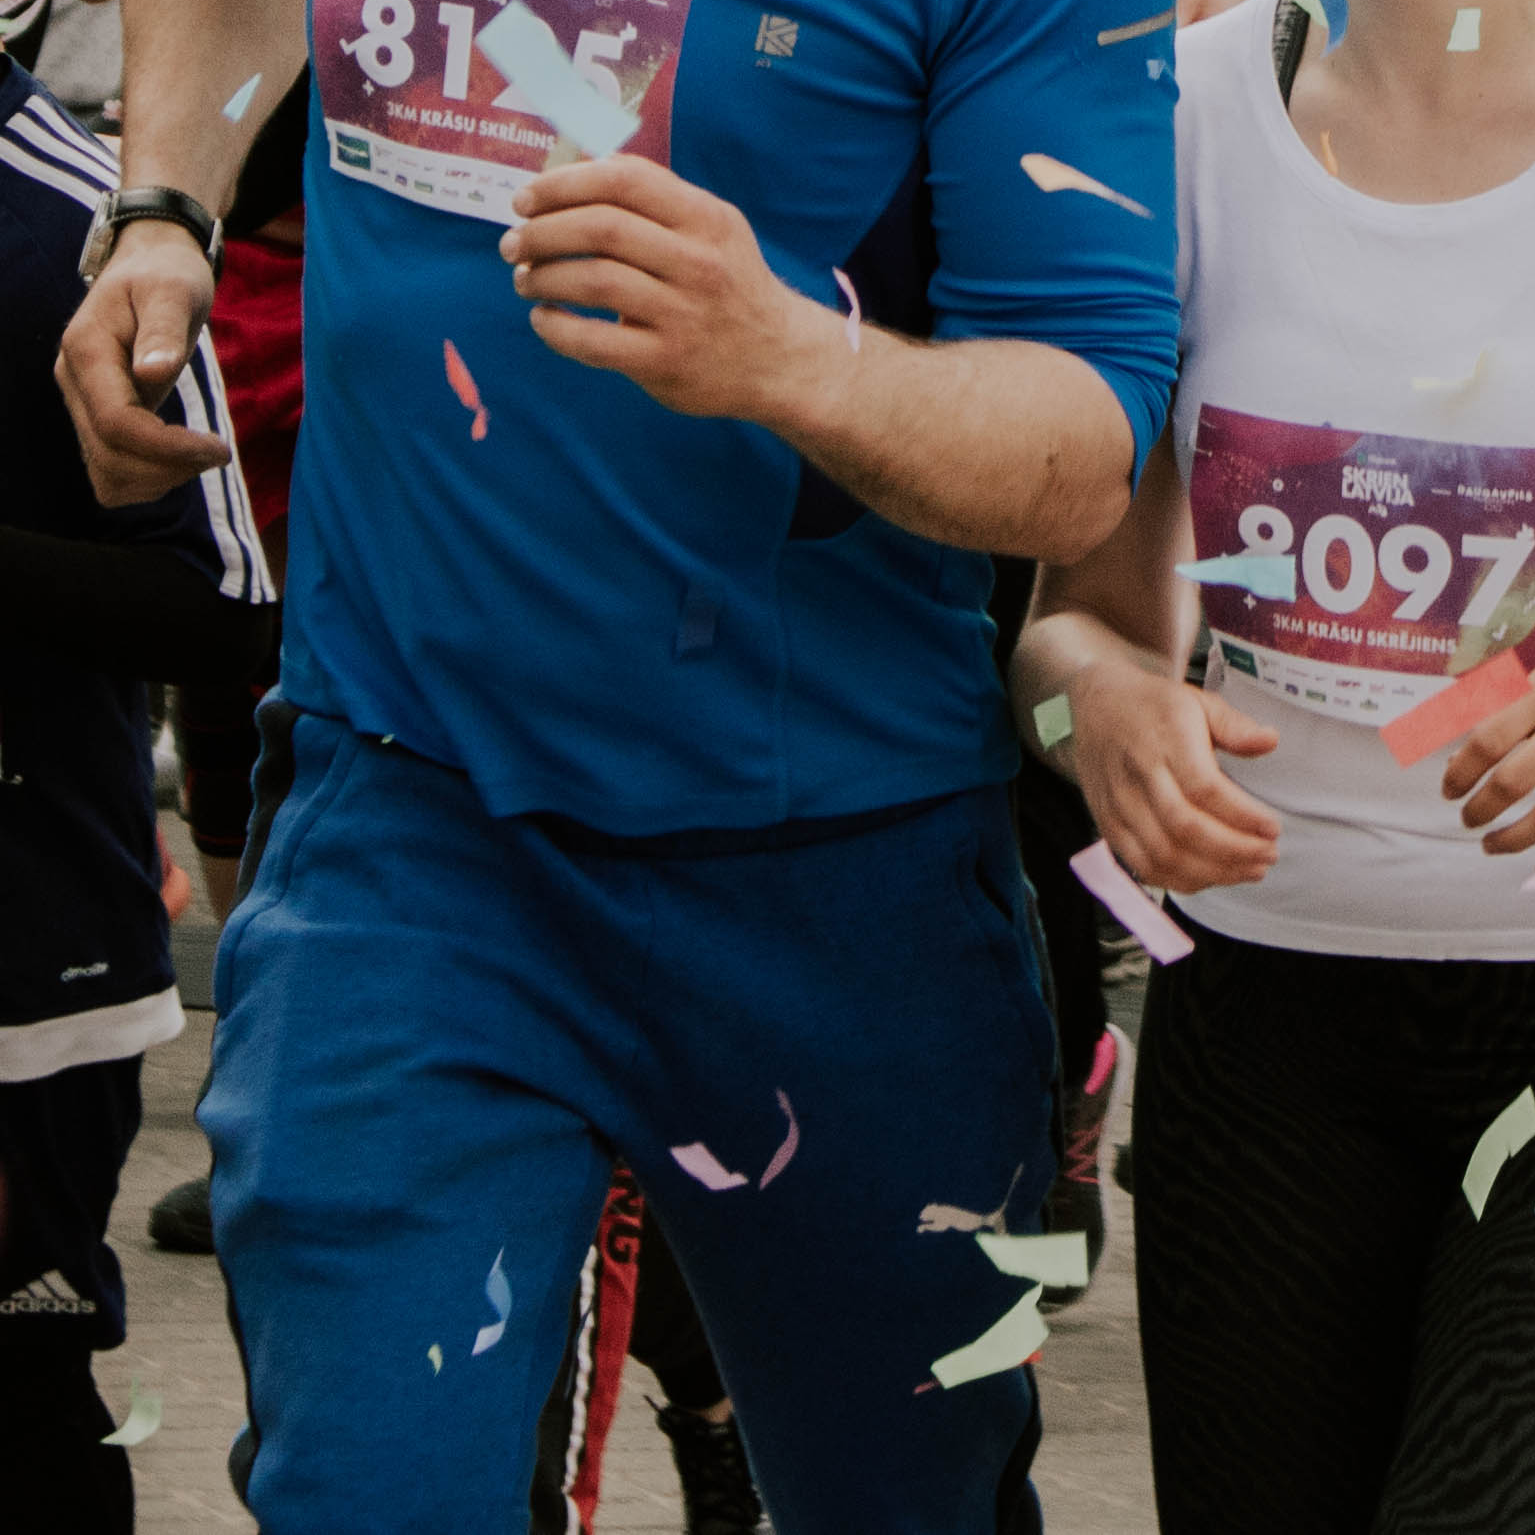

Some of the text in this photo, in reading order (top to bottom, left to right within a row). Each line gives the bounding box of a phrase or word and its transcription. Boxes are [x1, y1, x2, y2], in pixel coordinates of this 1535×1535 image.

[386, 101, 556, 151] 3KM KRĀSU SKRĒJIENS
[1272, 614, 1457, 655] 3KM KRĀSU SKRĒJIENS
[0, 1298, 97, 1314] adidas
